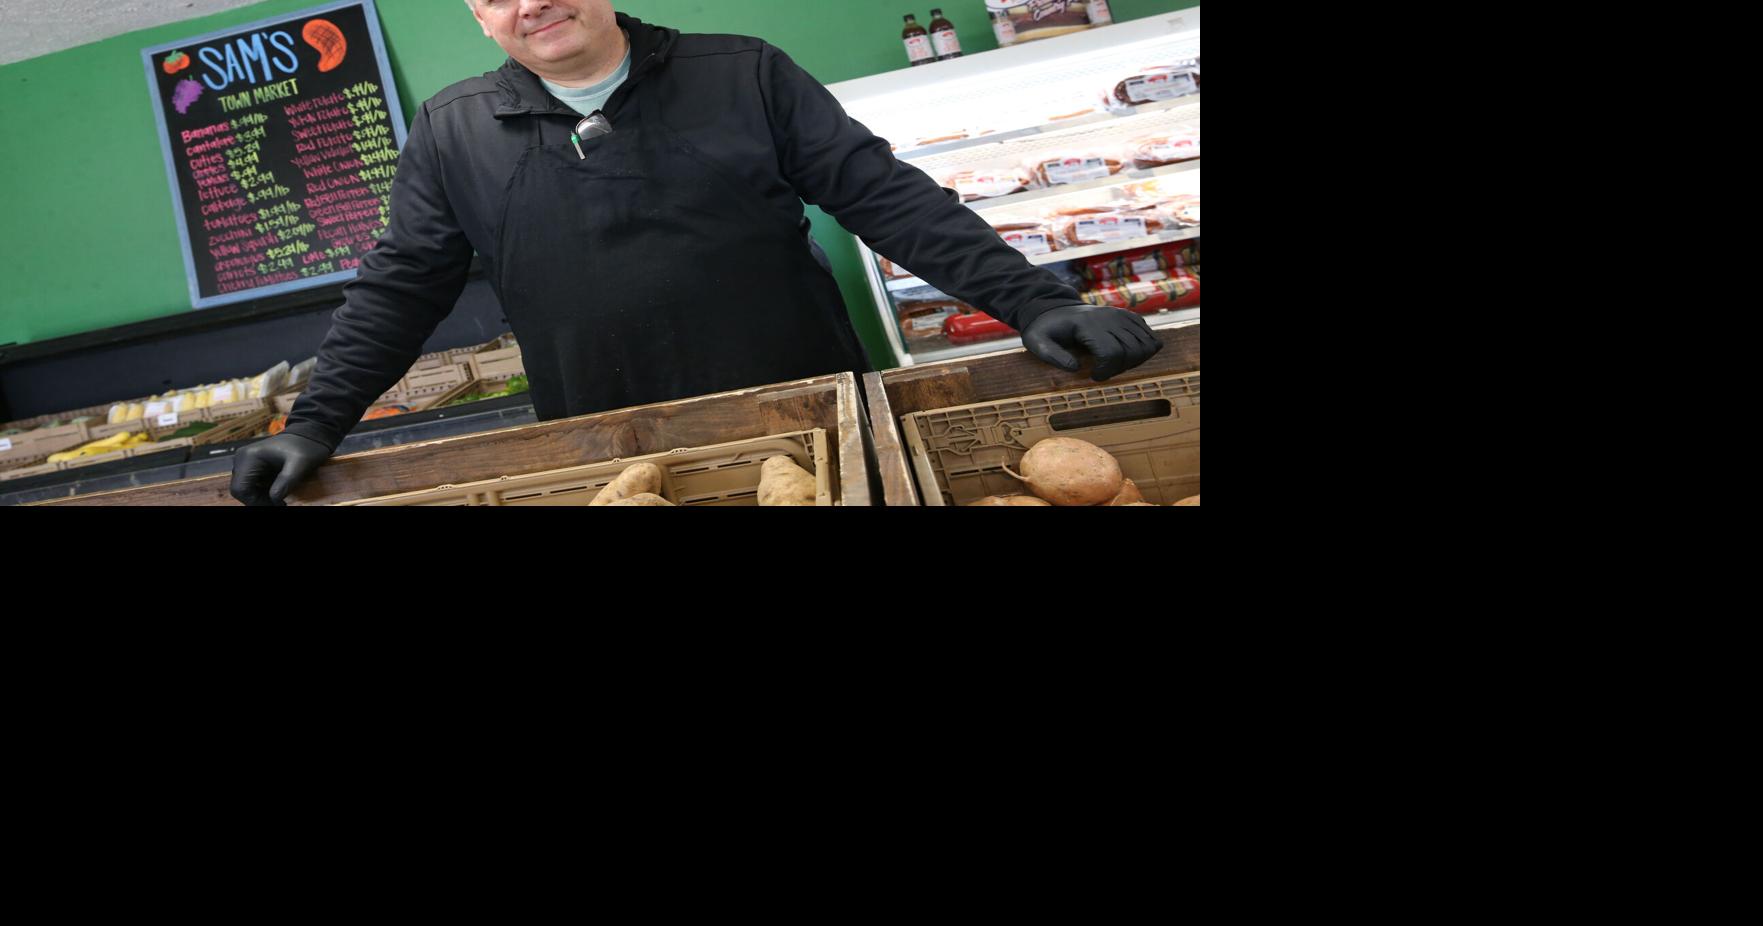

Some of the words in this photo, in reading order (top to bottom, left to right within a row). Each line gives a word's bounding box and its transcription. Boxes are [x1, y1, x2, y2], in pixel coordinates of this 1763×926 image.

[199, 30, 298, 91] SAM'S
[219, 93, 252, 113] TOWN
[253, 78, 299, 107] MARKET
[181, 121, 230, 143] Bananas
